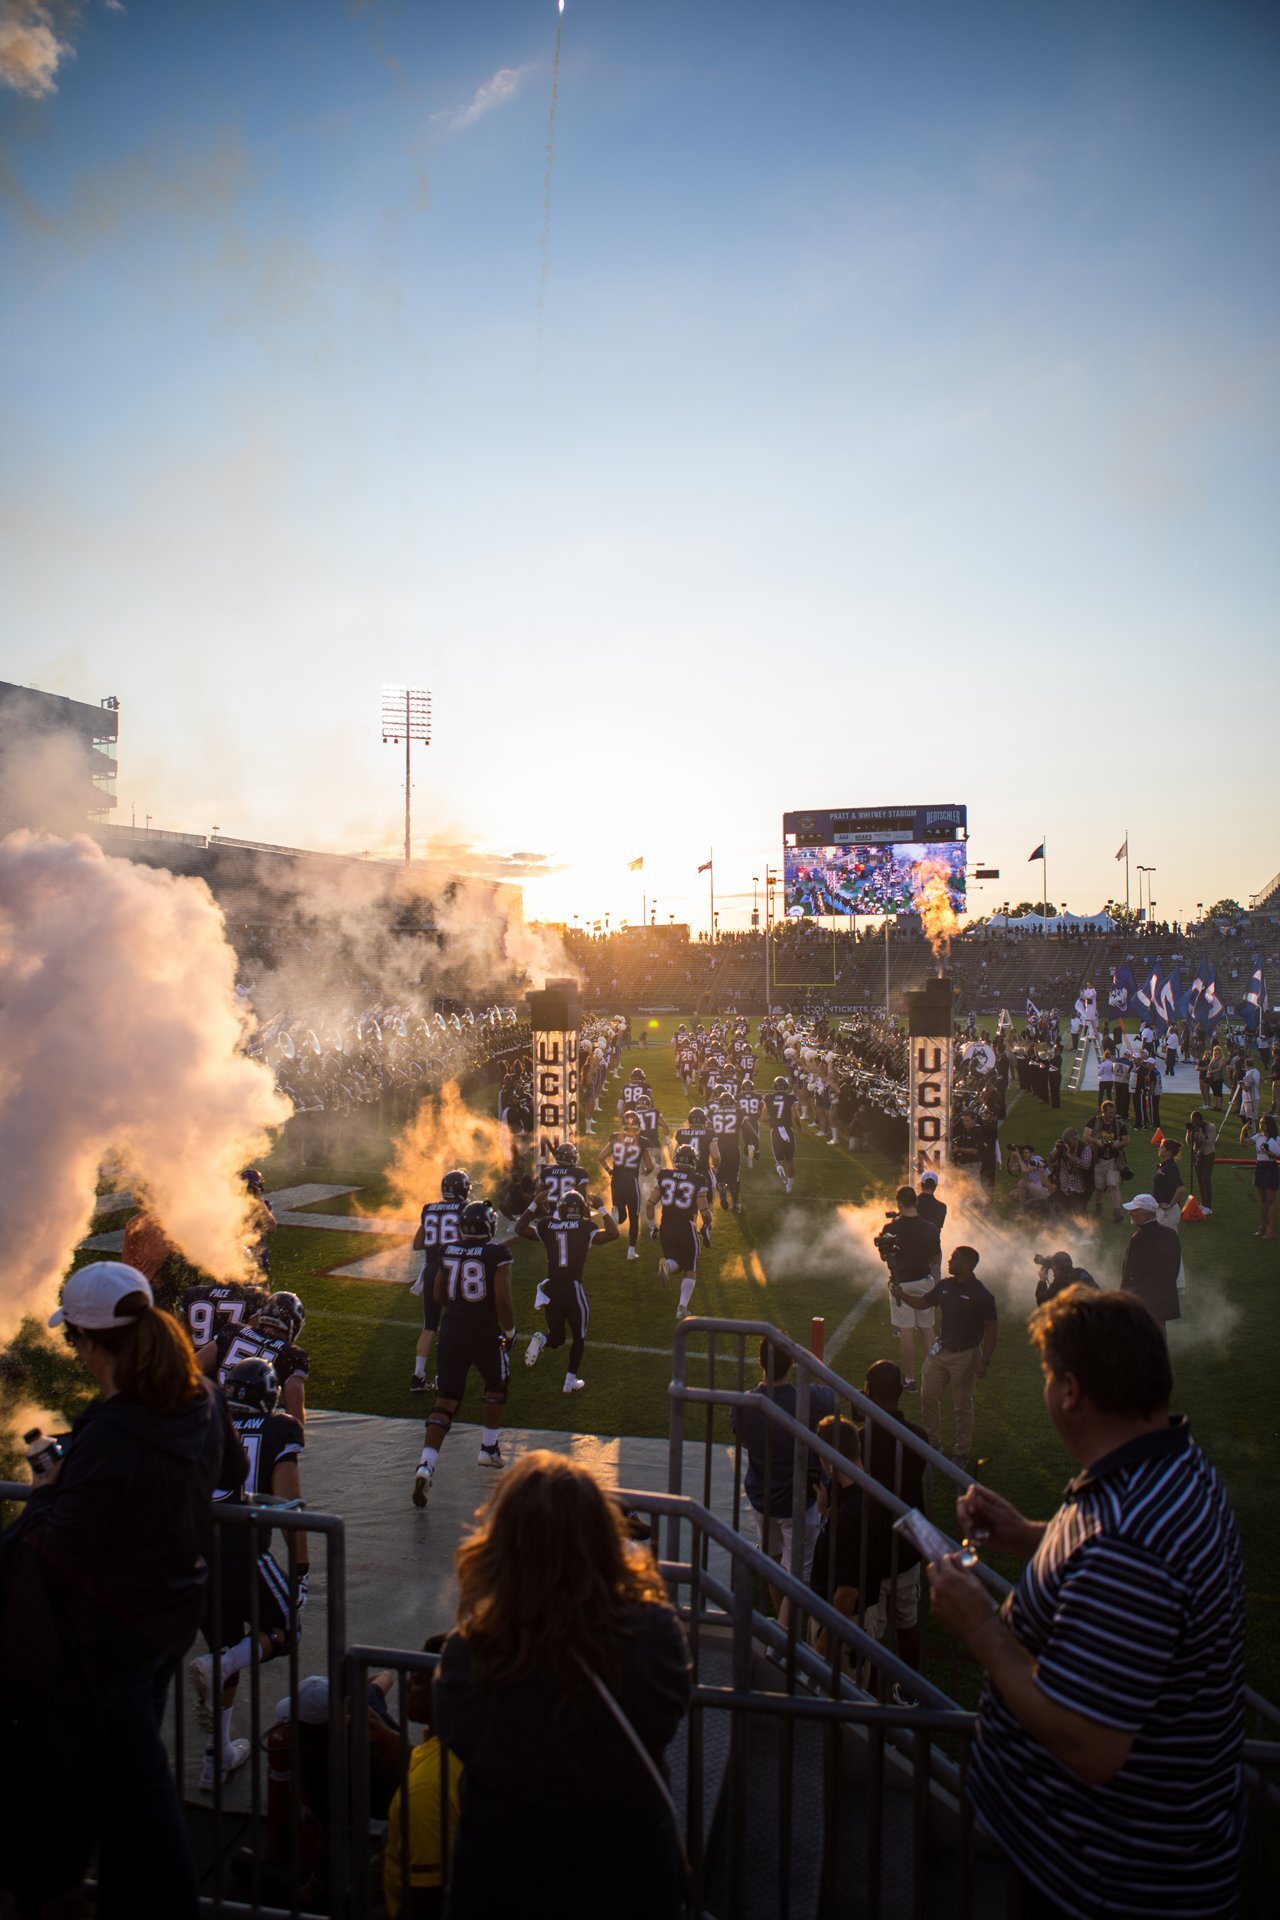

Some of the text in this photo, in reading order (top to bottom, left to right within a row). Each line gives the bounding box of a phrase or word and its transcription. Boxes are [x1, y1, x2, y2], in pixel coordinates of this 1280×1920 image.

[829, 812, 849, 820] PRATT
[858, 811, 887, 819] WHITNEY
[888, 809, 917, 818] STADIUM
[926, 810, 960, 826] RENTSCHLER
[680, 1050, 693, 1061] 28
[740, 1058, 754, 1070] 45
[624, 1087, 643, 1103] 98
[773, 1101, 784, 1118] 7
[712, 1114, 737, 1133] 62
[612, 1142, 641, 1168] 92
[660, 1178, 695, 1209] 33
[424, 1212, 460, 1246] 66
[556, 1231, 568, 1268] 1
[441, 1257, 487, 1302] 78
[209, 1288, 231, 1298] PACE
[188, 1300, 247, 1348] 97
